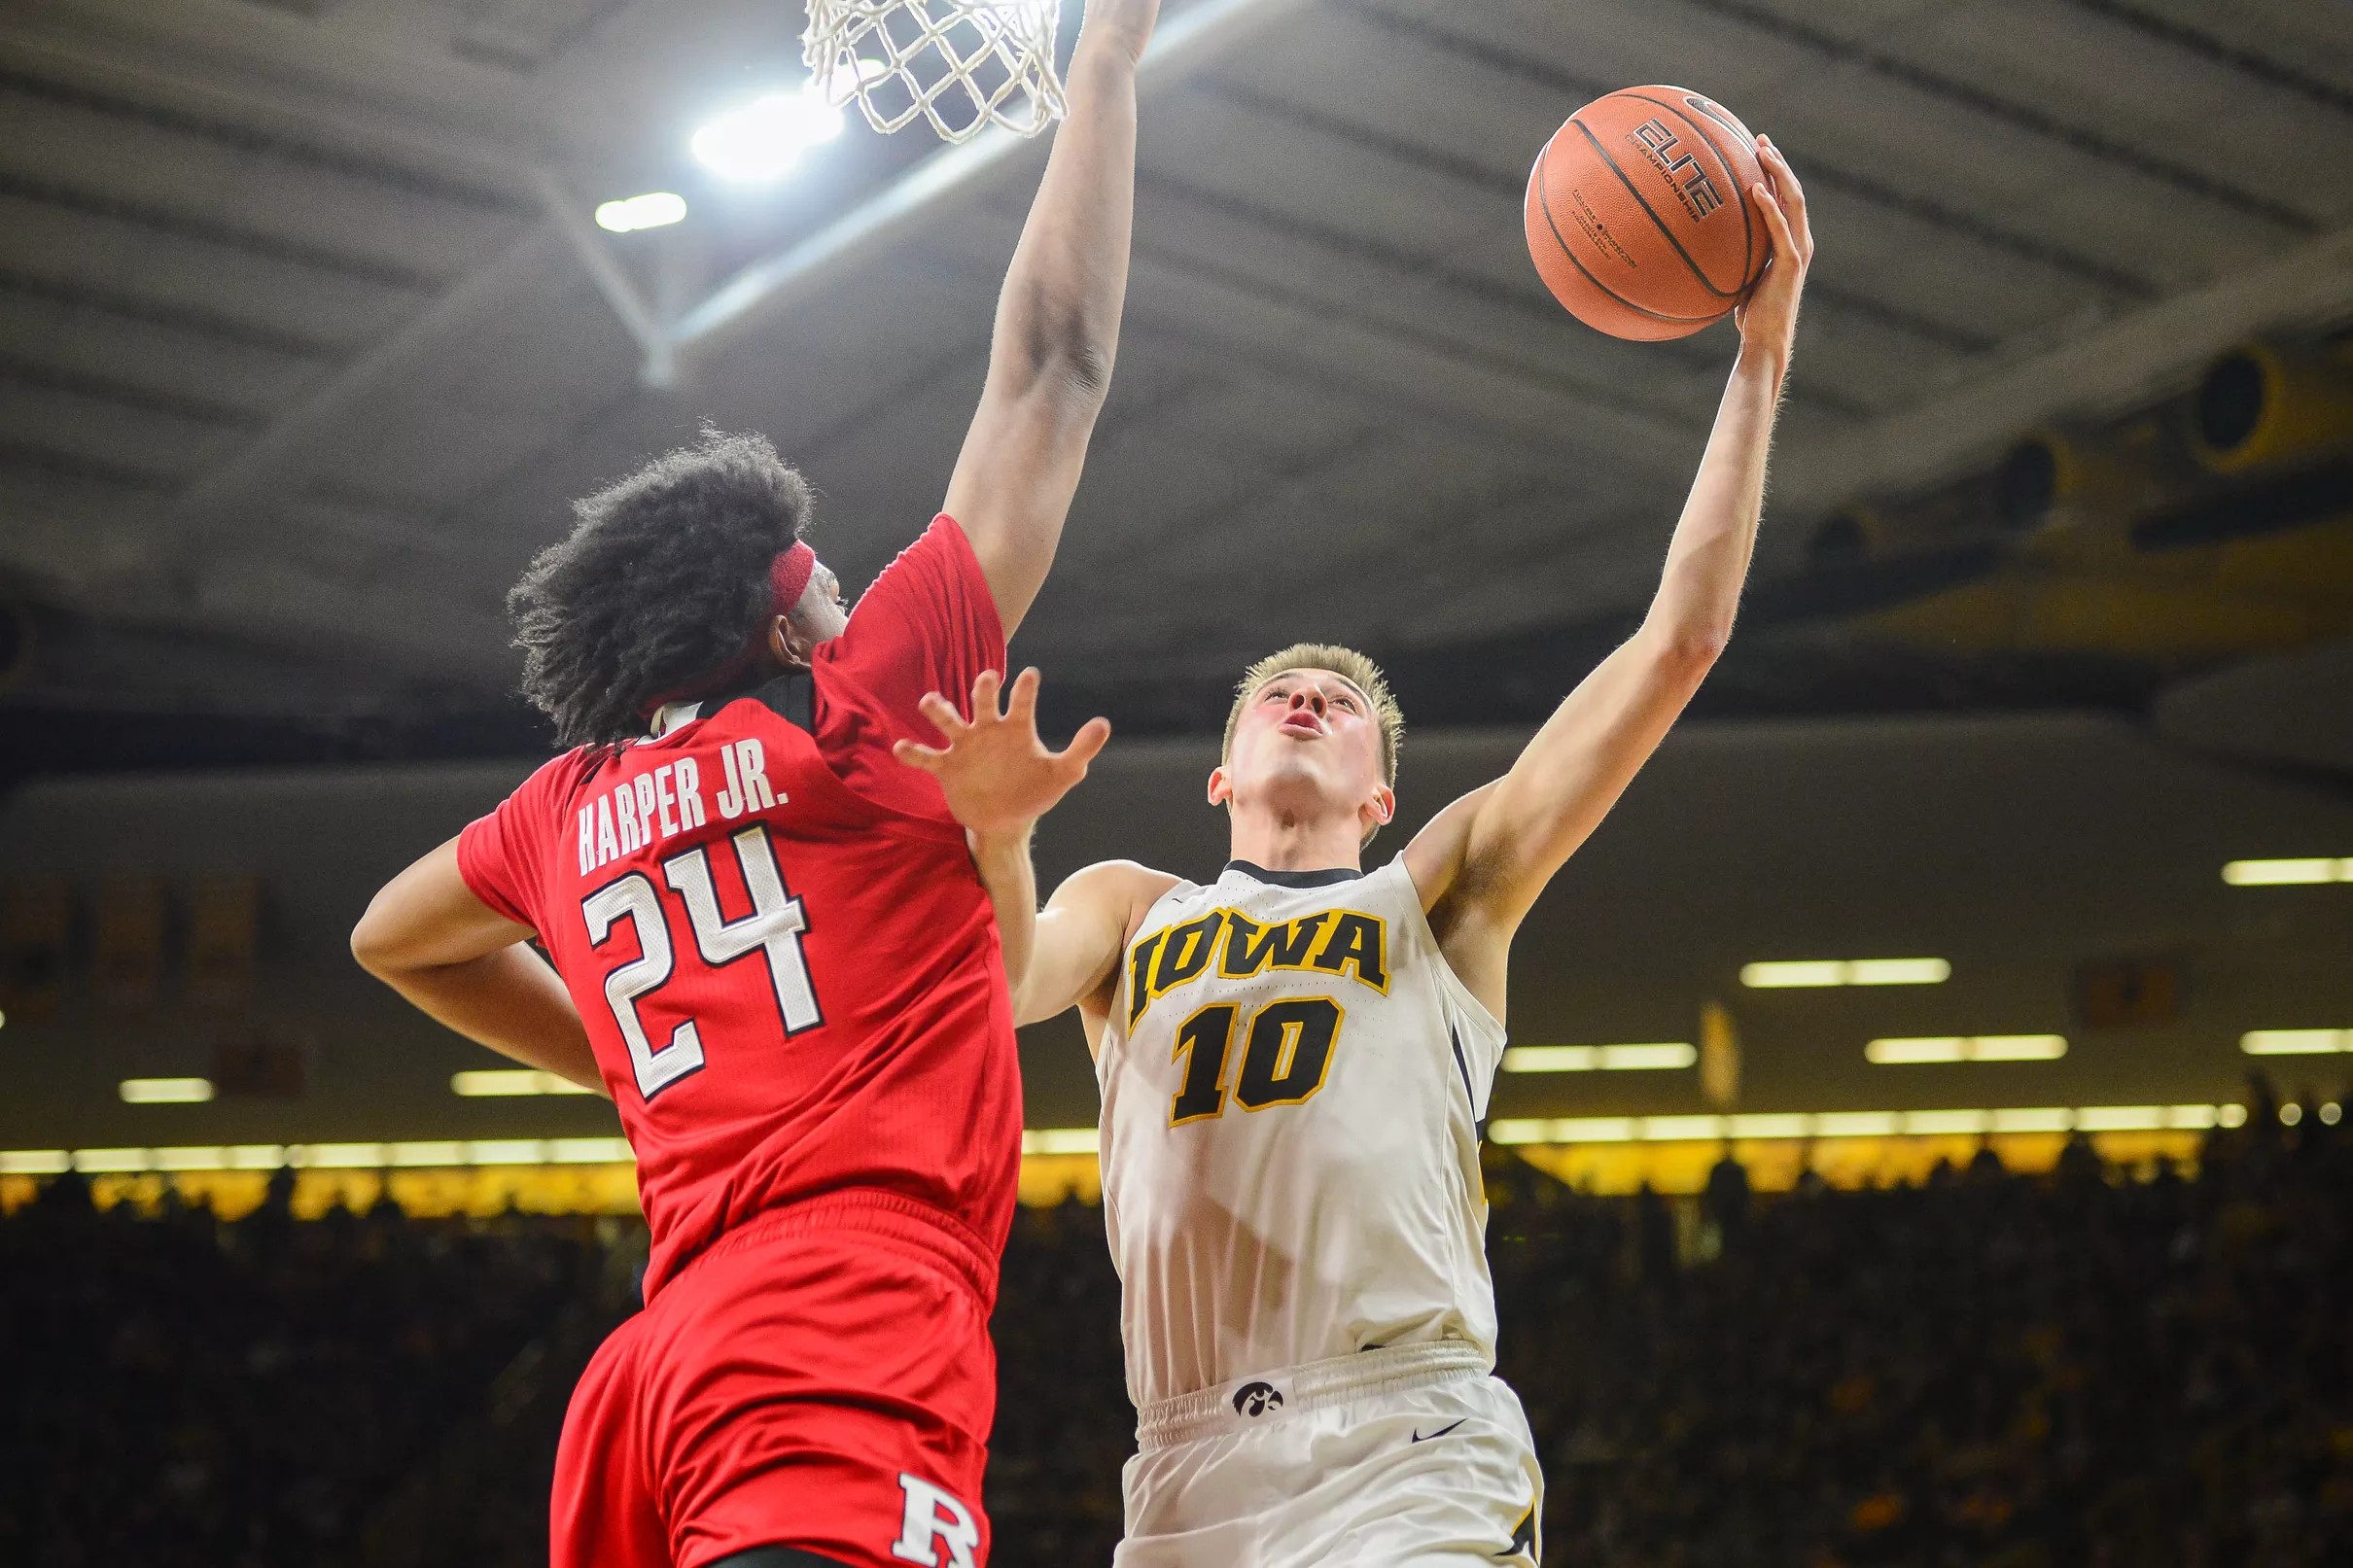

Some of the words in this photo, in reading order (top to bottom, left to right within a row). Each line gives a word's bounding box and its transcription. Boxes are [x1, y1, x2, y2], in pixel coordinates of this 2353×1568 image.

[1626, 134, 1701, 224] CHAMPIONSHIP
[1633, 118, 1724, 218] ELITE
[578, 756, 707, 877] HARPER
[717, 737, 790, 819] JR.
[580, 819, 825, 1103] 24
[1128, 906, 1391, 1041] IOWA
[1169, 995, 1346, 1129] 10
[892, 1472, 980, 1568] R
